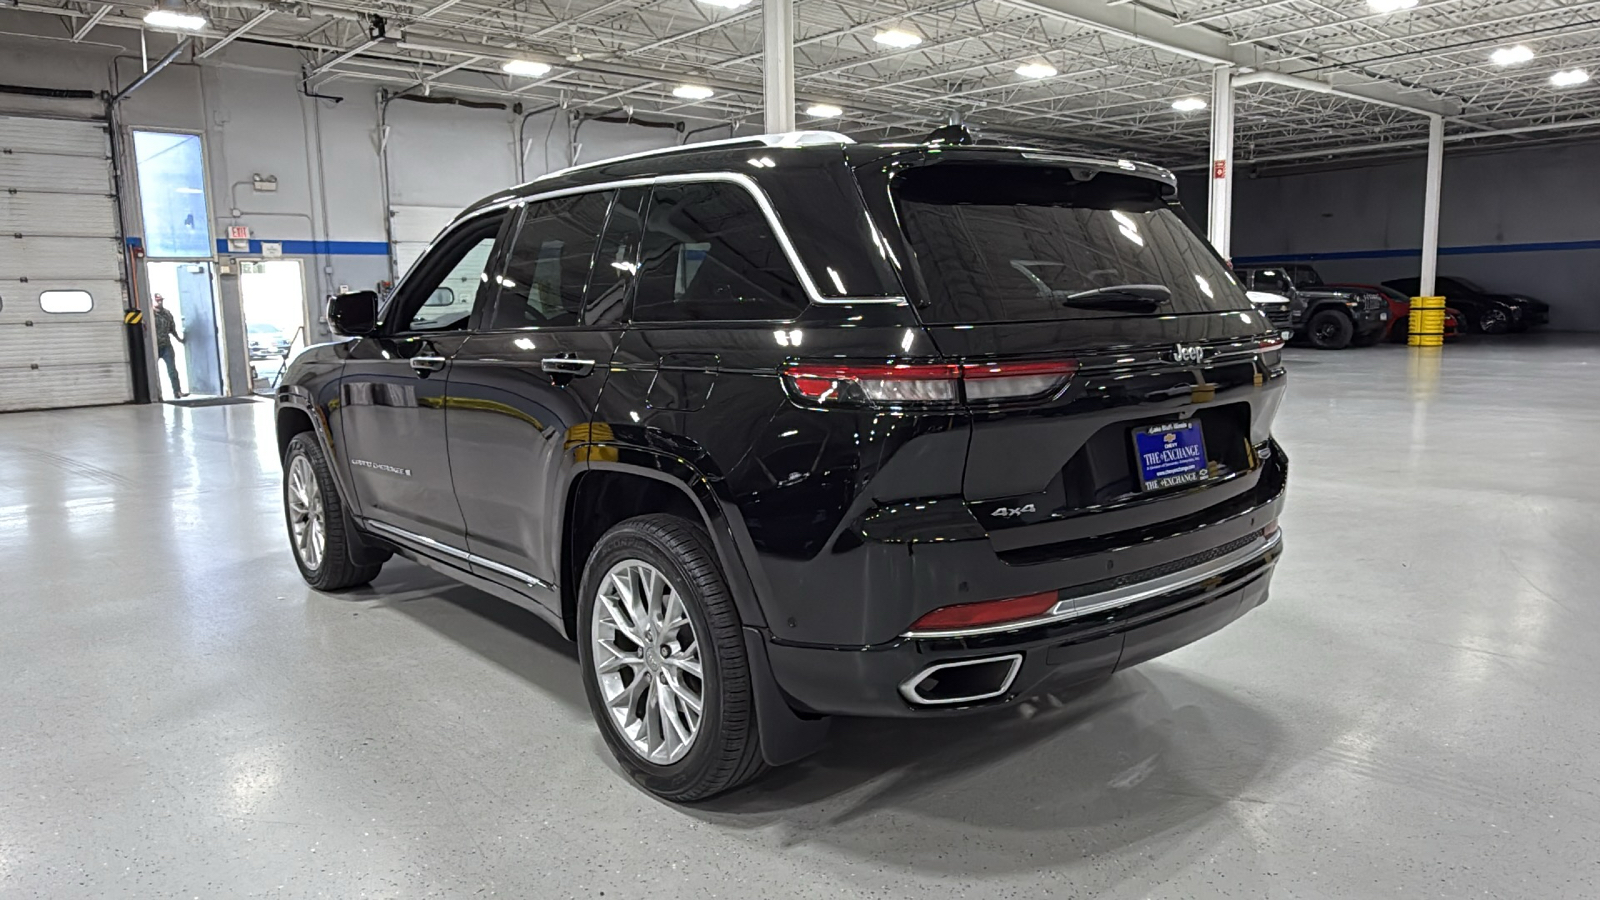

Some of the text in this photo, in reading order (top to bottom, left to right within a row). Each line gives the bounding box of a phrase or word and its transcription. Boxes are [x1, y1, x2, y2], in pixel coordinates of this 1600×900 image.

[231, 227, 247, 238] EXIT
[1173, 343, 1204, 364] Jeep
[1143, 451, 1161, 466] THE
[1163, 445, 1200, 462] EXCHANGE
[1145, 480, 1160, 491] THE
[1164, 473, 1198, 487] EXCHANGE
